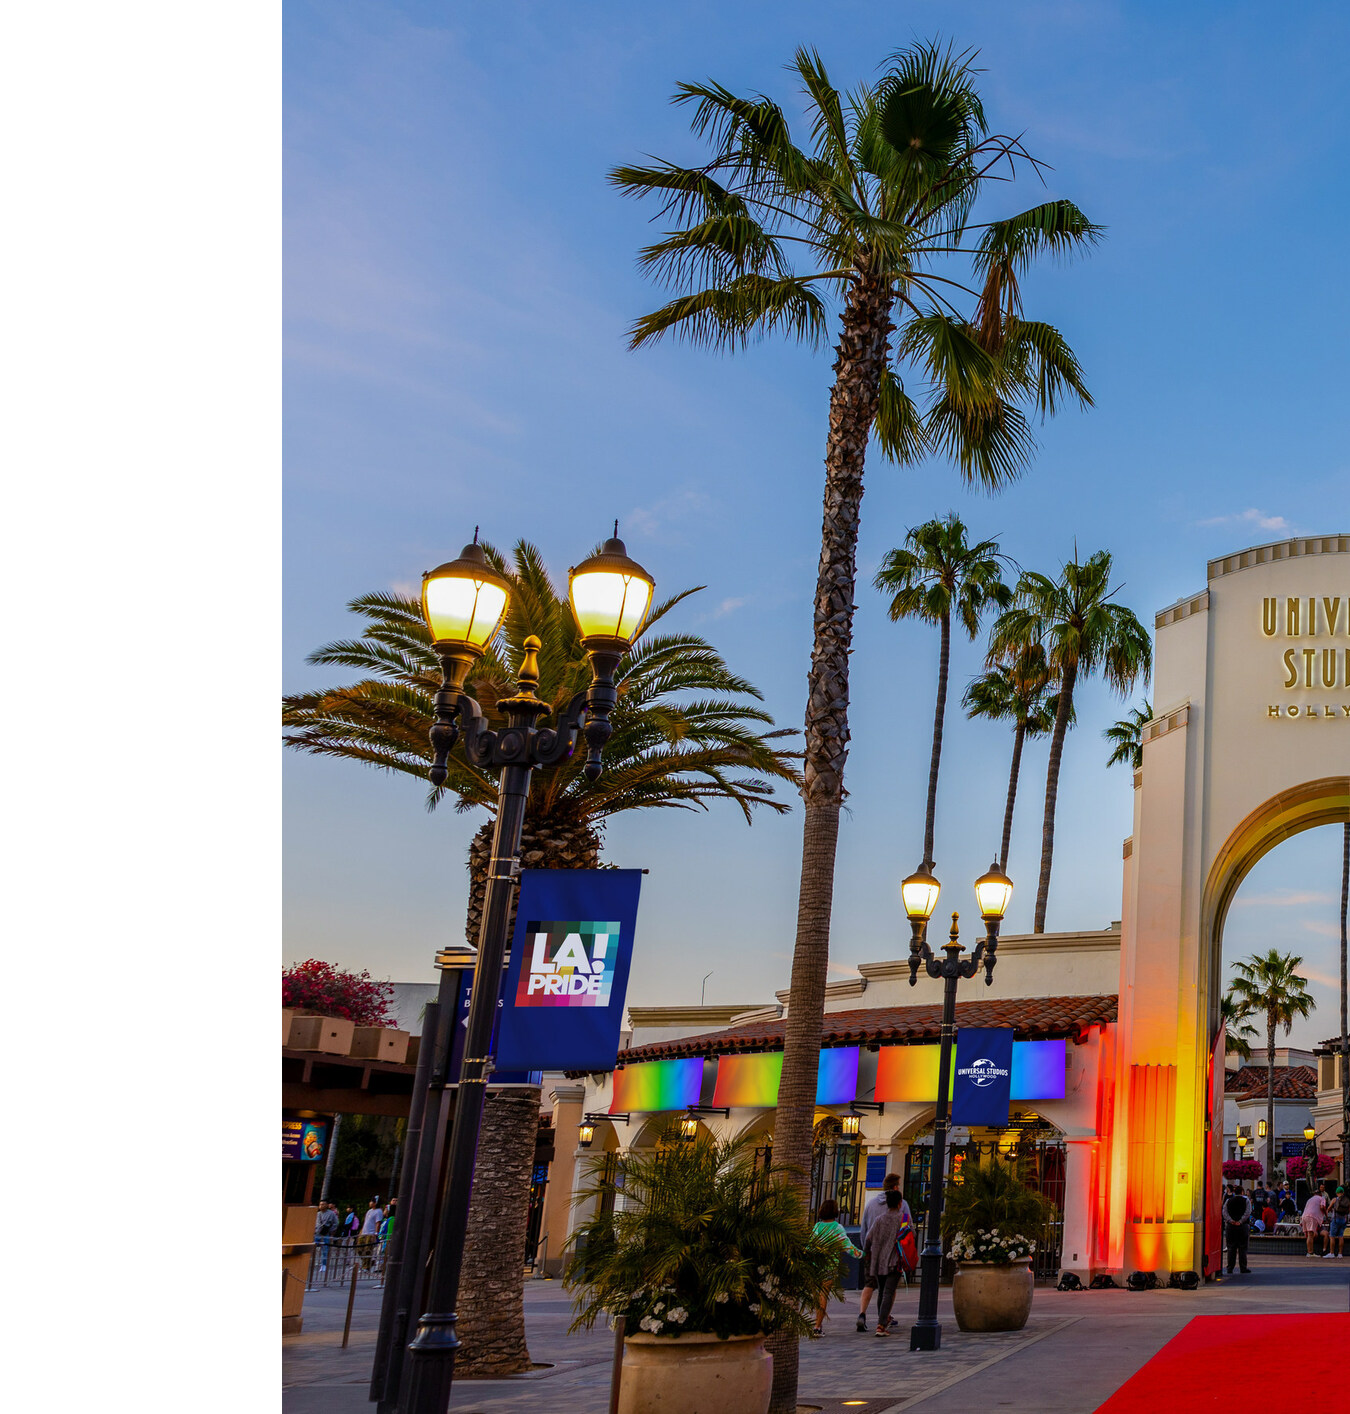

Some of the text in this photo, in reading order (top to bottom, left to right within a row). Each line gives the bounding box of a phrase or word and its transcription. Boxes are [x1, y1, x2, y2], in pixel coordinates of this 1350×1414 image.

[530, 933, 609, 974] LA!
[527, 974, 603, 995] PRIDE
[986, 1068, 1008, 1076] STUDIOS
